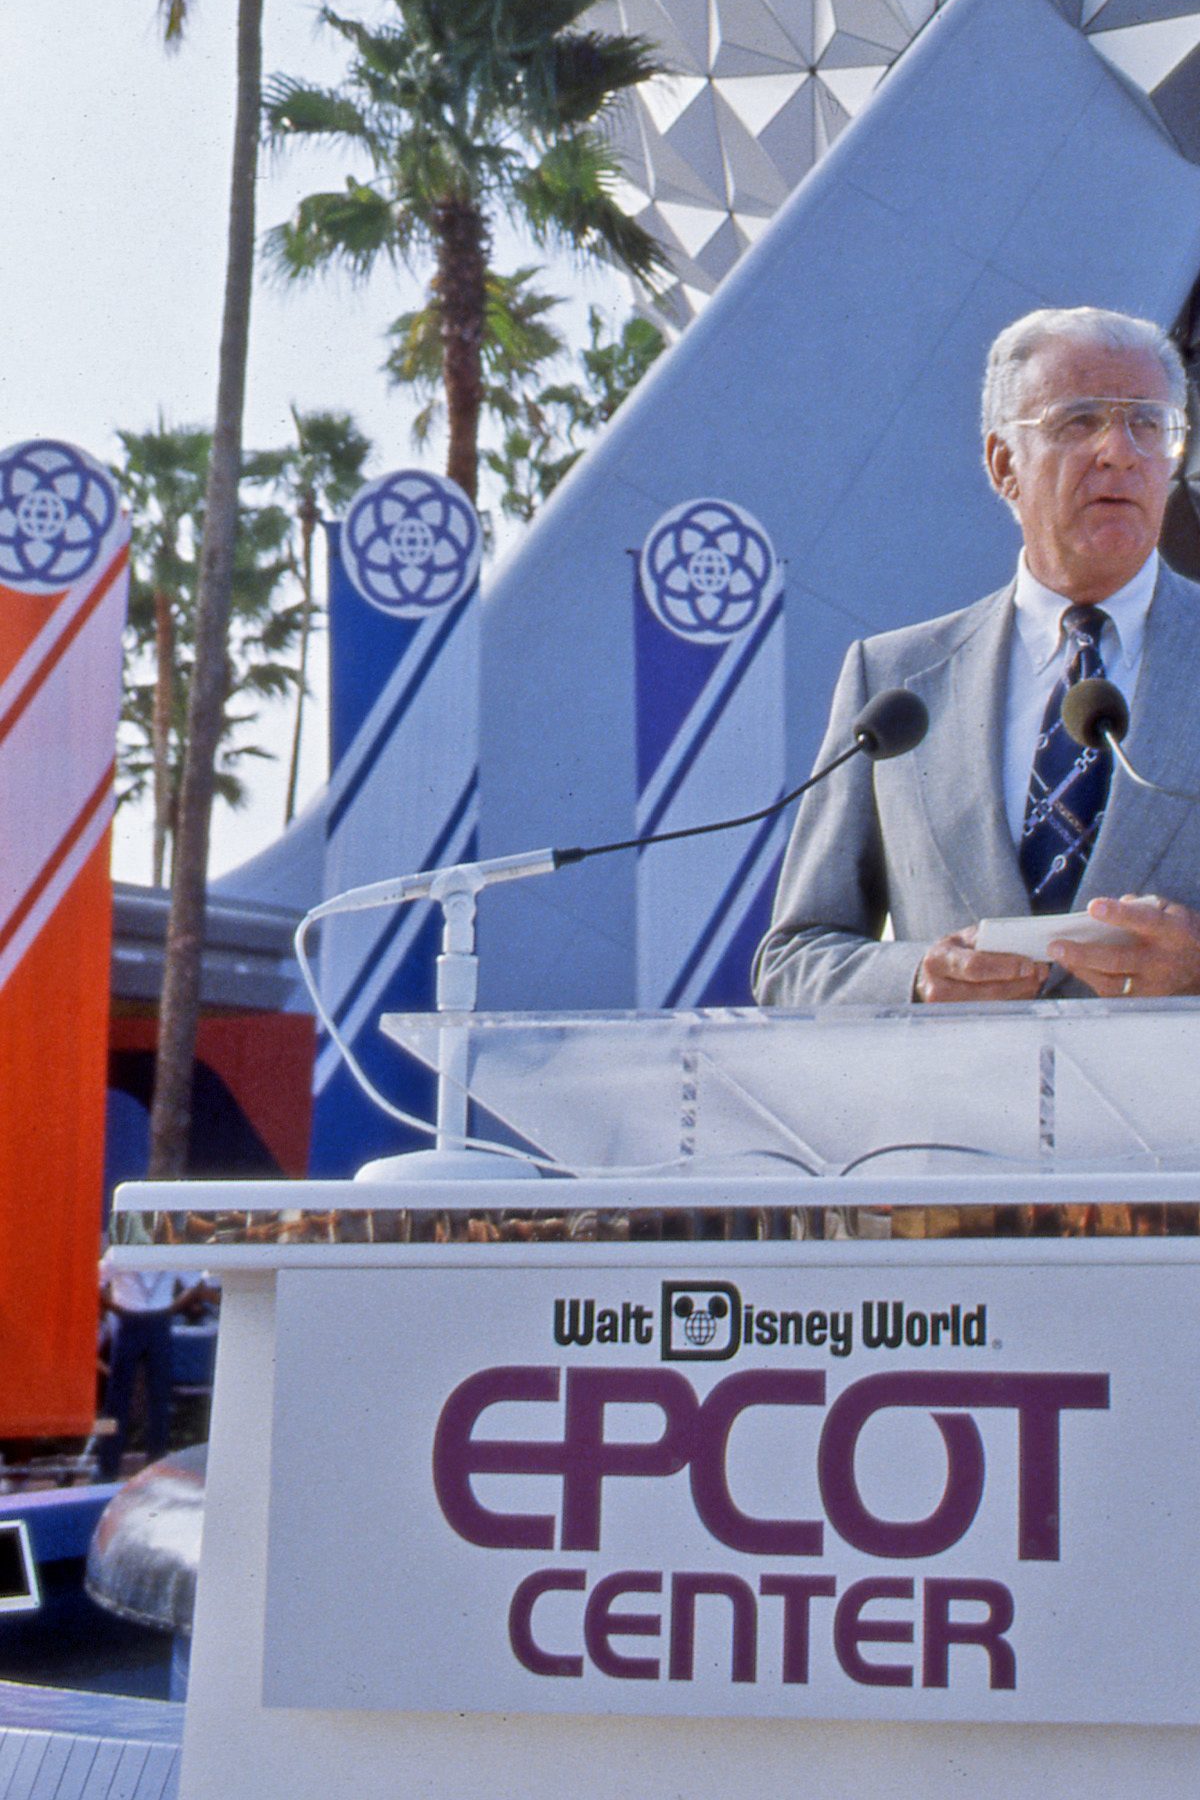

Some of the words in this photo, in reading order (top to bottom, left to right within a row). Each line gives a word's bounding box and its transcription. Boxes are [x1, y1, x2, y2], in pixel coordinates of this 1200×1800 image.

[553, 1298, 654, 1347] Walt
[660, 1280, 853, 1362] Disney
[862, 1301, 987, 1350] World
[432, 1365, 1111, 1562] EPCOT
[508, 1568, 1017, 1691] CENTER
